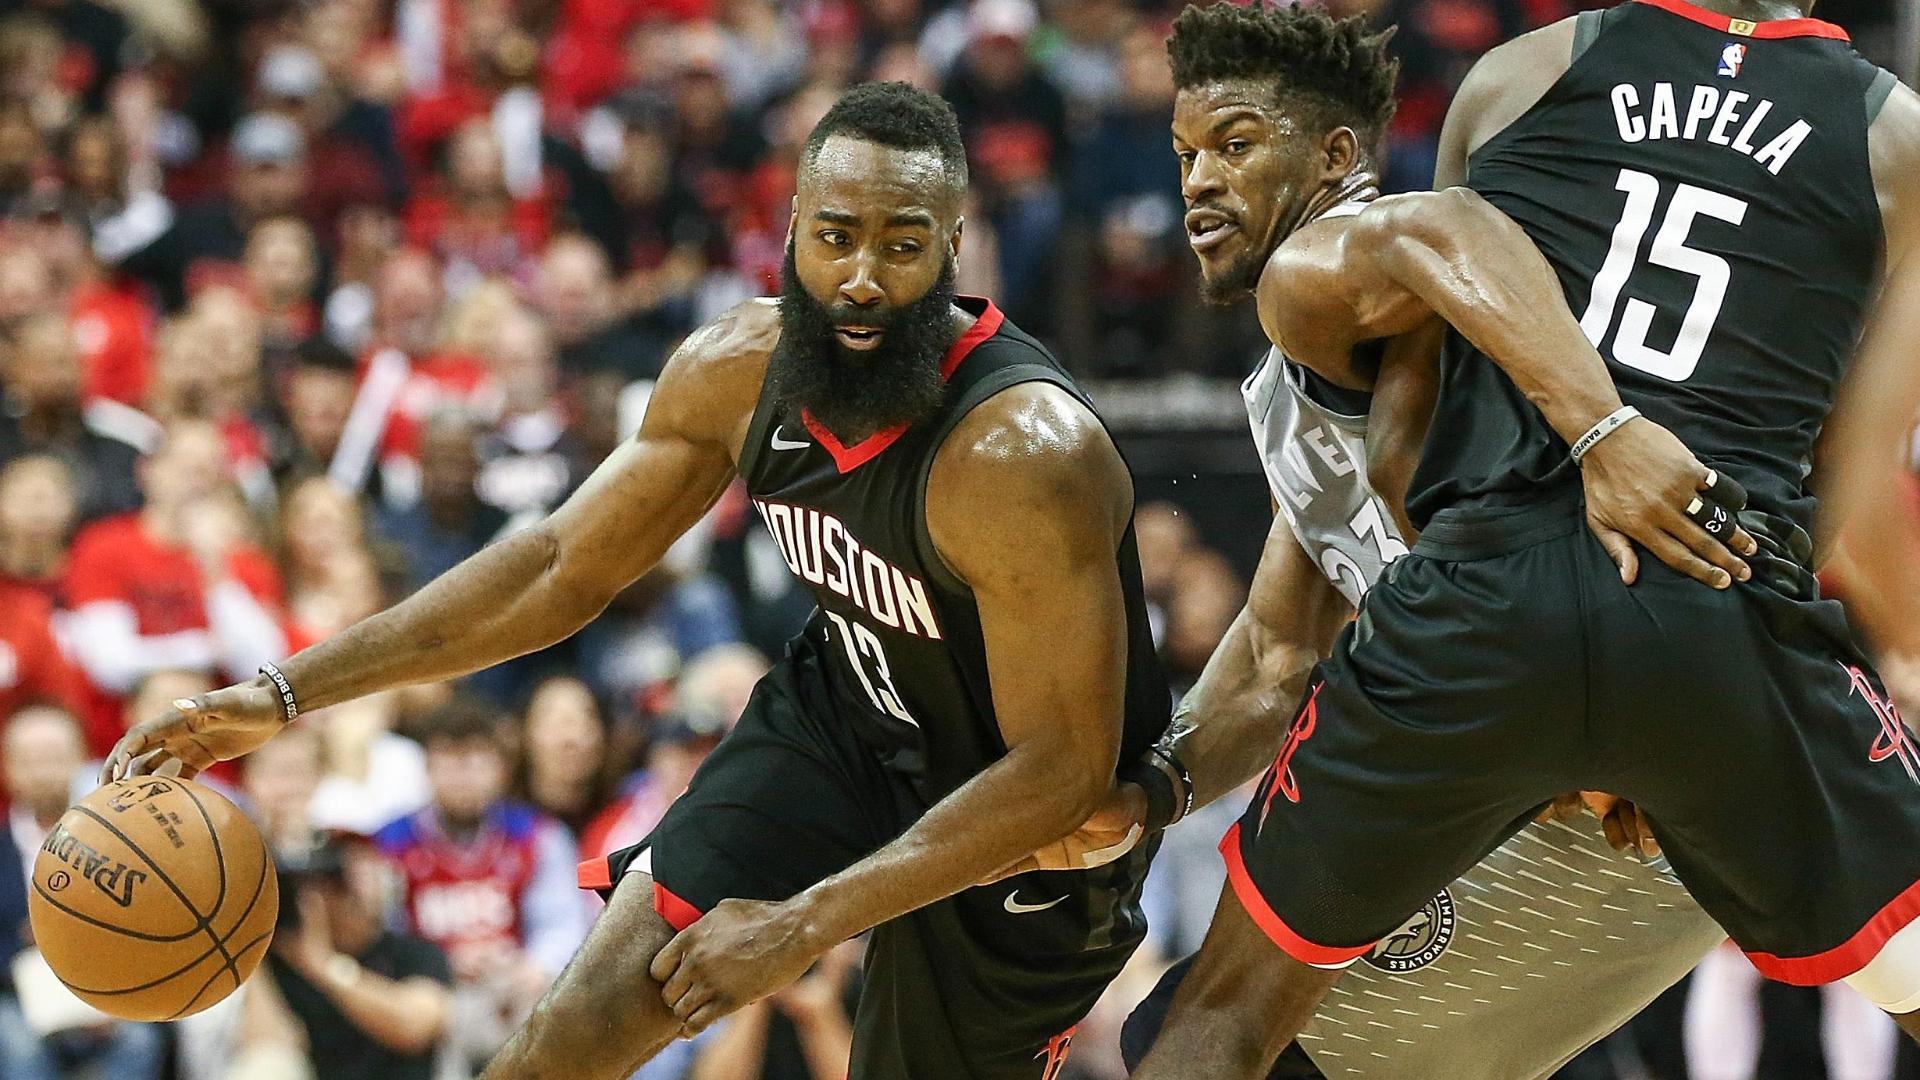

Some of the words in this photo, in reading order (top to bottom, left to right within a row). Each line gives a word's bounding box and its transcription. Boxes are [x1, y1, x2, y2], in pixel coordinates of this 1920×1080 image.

[1610, 82, 1813, 176] CAPELA
[1579, 168, 1749, 382] 15
[1705, 506, 1728, 533] 23
[824, 609, 920, 729] 13
[1389, 889, 1453, 970] TIMBERWOLVES
